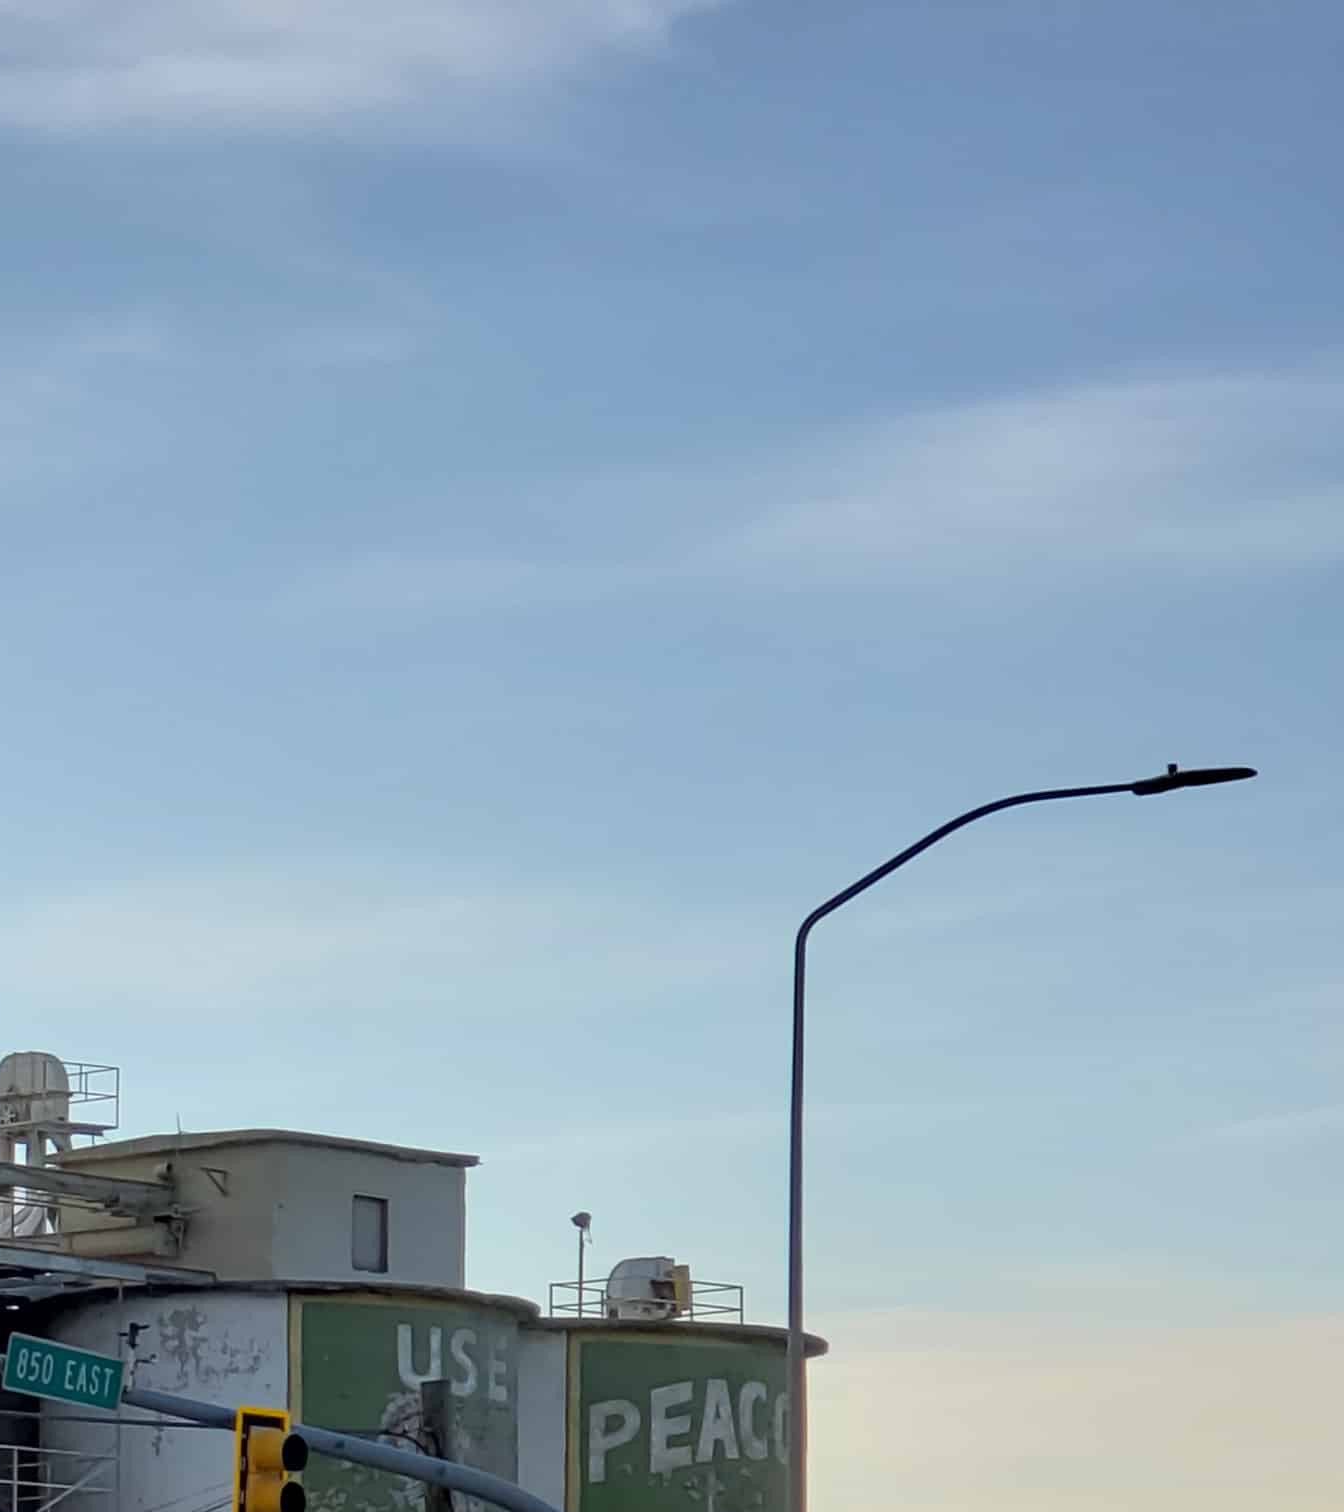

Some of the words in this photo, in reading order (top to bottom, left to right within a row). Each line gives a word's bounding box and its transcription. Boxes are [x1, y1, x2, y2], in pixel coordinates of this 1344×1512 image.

[16, 1348, 54, 1385] 850
[64, 1360, 115, 1398] EAST
[397, 1323, 508, 1401] USE
